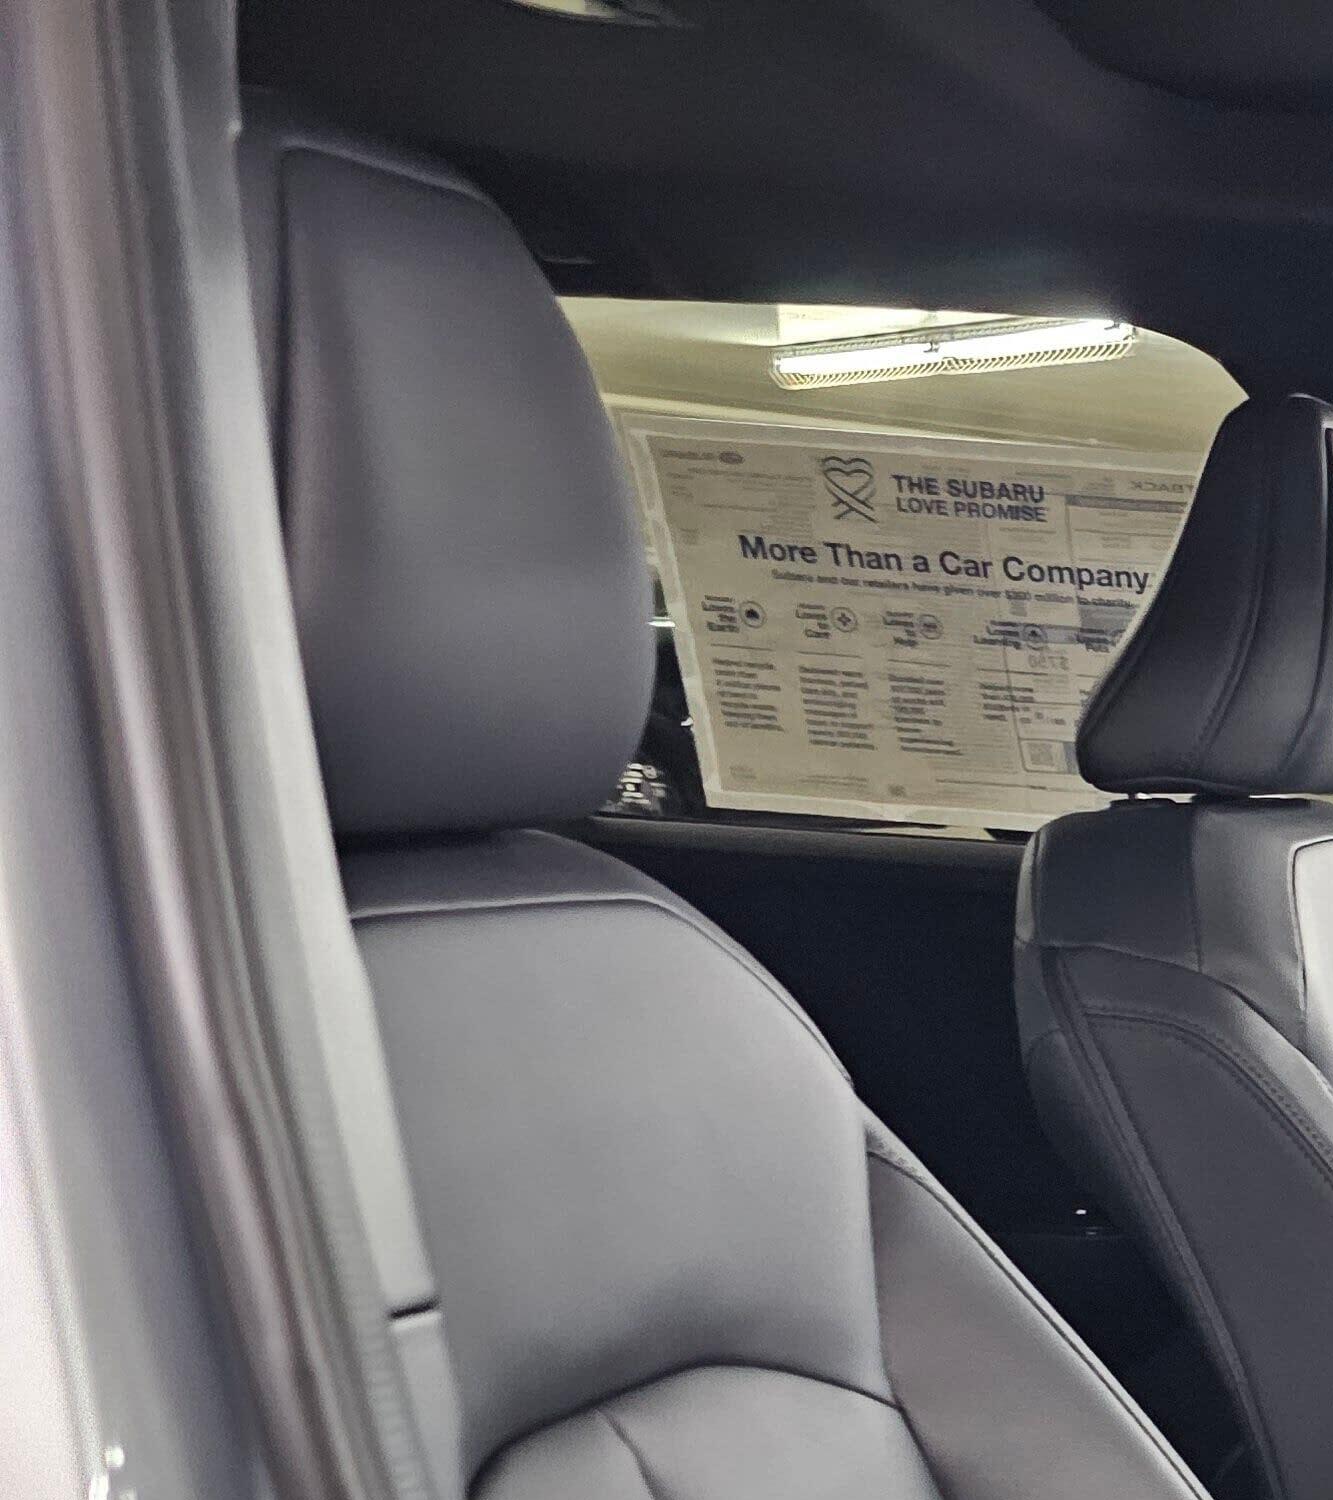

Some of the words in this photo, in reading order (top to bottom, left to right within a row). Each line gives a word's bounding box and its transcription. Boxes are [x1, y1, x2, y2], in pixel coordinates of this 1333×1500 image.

[890, 474, 940, 495] THE
[946, 478, 1045, 503] SUBARU
[896, 496, 949, 516] LOVE
[954, 499, 1048, 523] PROMISE
[738, 534, 818, 565] More
[823, 541, 904, 572] Than
[912, 554, 931, 574] a
[939, 549, 994, 579] Car
[1002, 556, 1150, 595] Company
